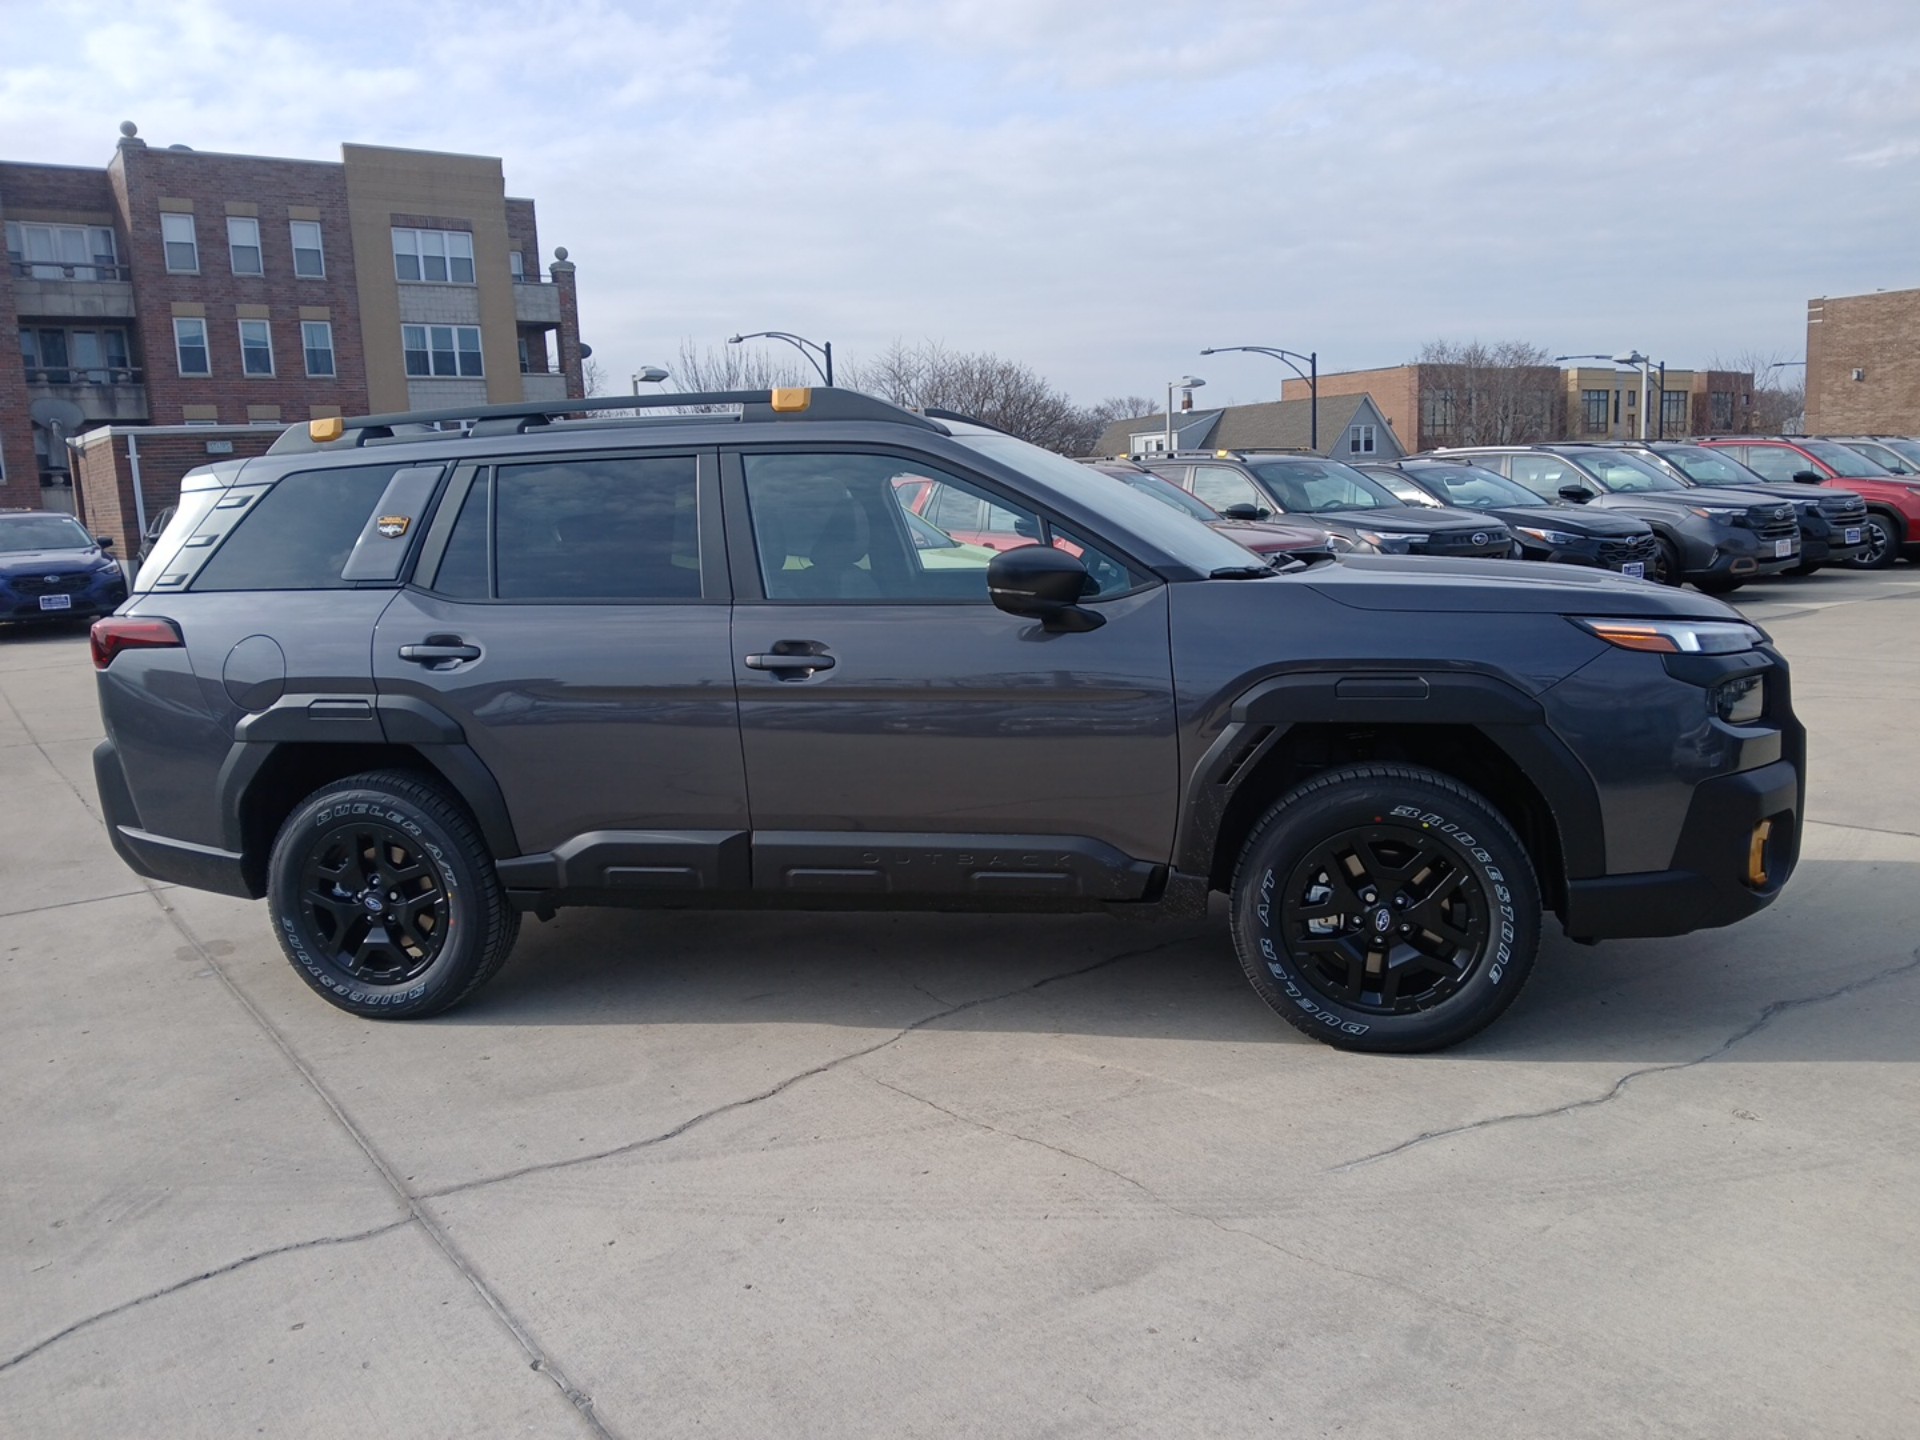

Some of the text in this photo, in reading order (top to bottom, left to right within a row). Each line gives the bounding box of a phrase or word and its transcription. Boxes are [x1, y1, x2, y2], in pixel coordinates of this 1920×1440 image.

[316, 803, 458, 887] DUELER A/T
[863, 853, 1071, 866] OUTBACK
[1389, 804, 1515, 985] BRIDGESTONE
[282, 916, 427, 1005] BRIDGESTONE
[1257, 868, 1370, 1036] DUELER A/T
